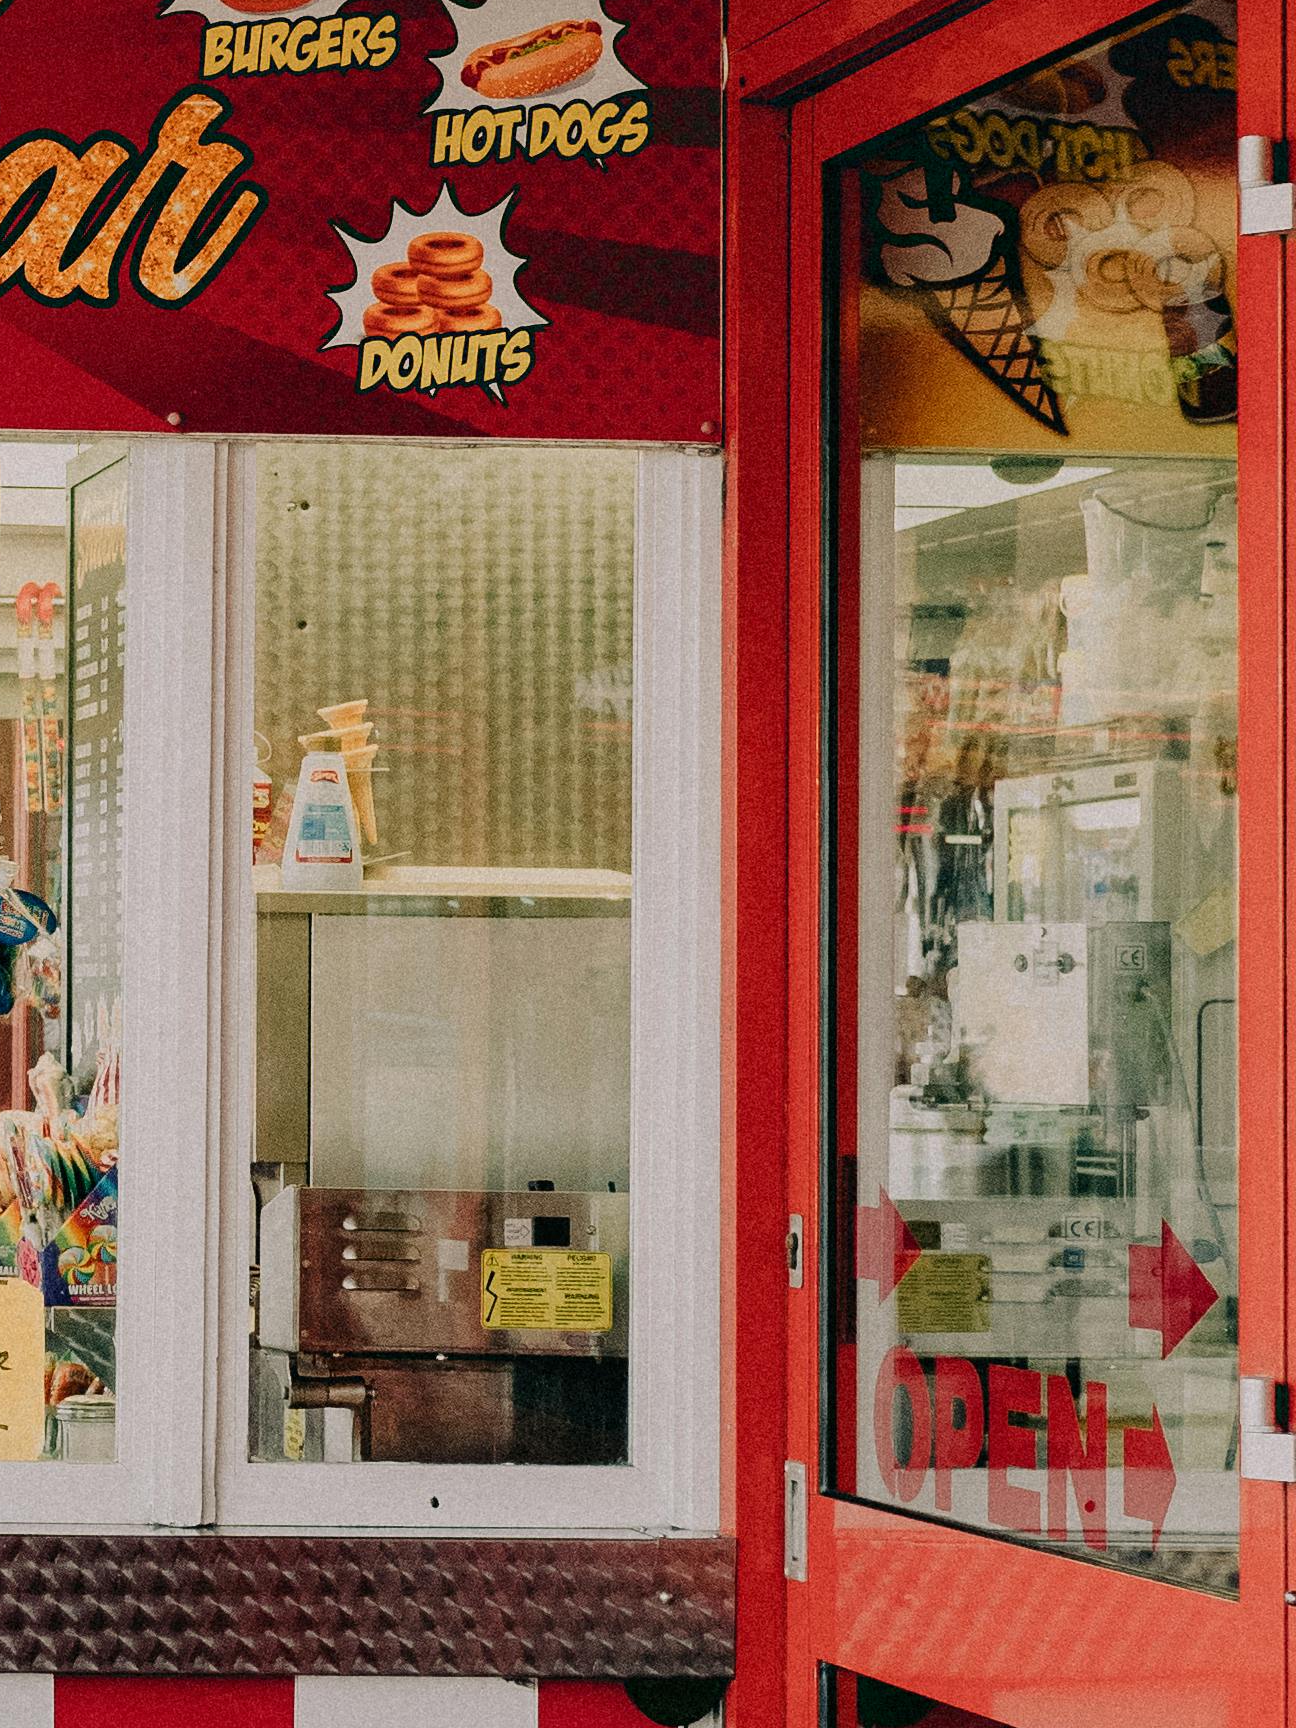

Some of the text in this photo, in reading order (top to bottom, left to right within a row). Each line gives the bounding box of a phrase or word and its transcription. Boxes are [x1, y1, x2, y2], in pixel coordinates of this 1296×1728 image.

[202, 11, 399, 77] BURGERS
[430, 96, 651, 168] HOT DOGS
[358, 326, 534, 395] DONUTS
[68, 1285, 105, 1296] WHEEL
[872, 1344, 1107, 1552] OPEN
